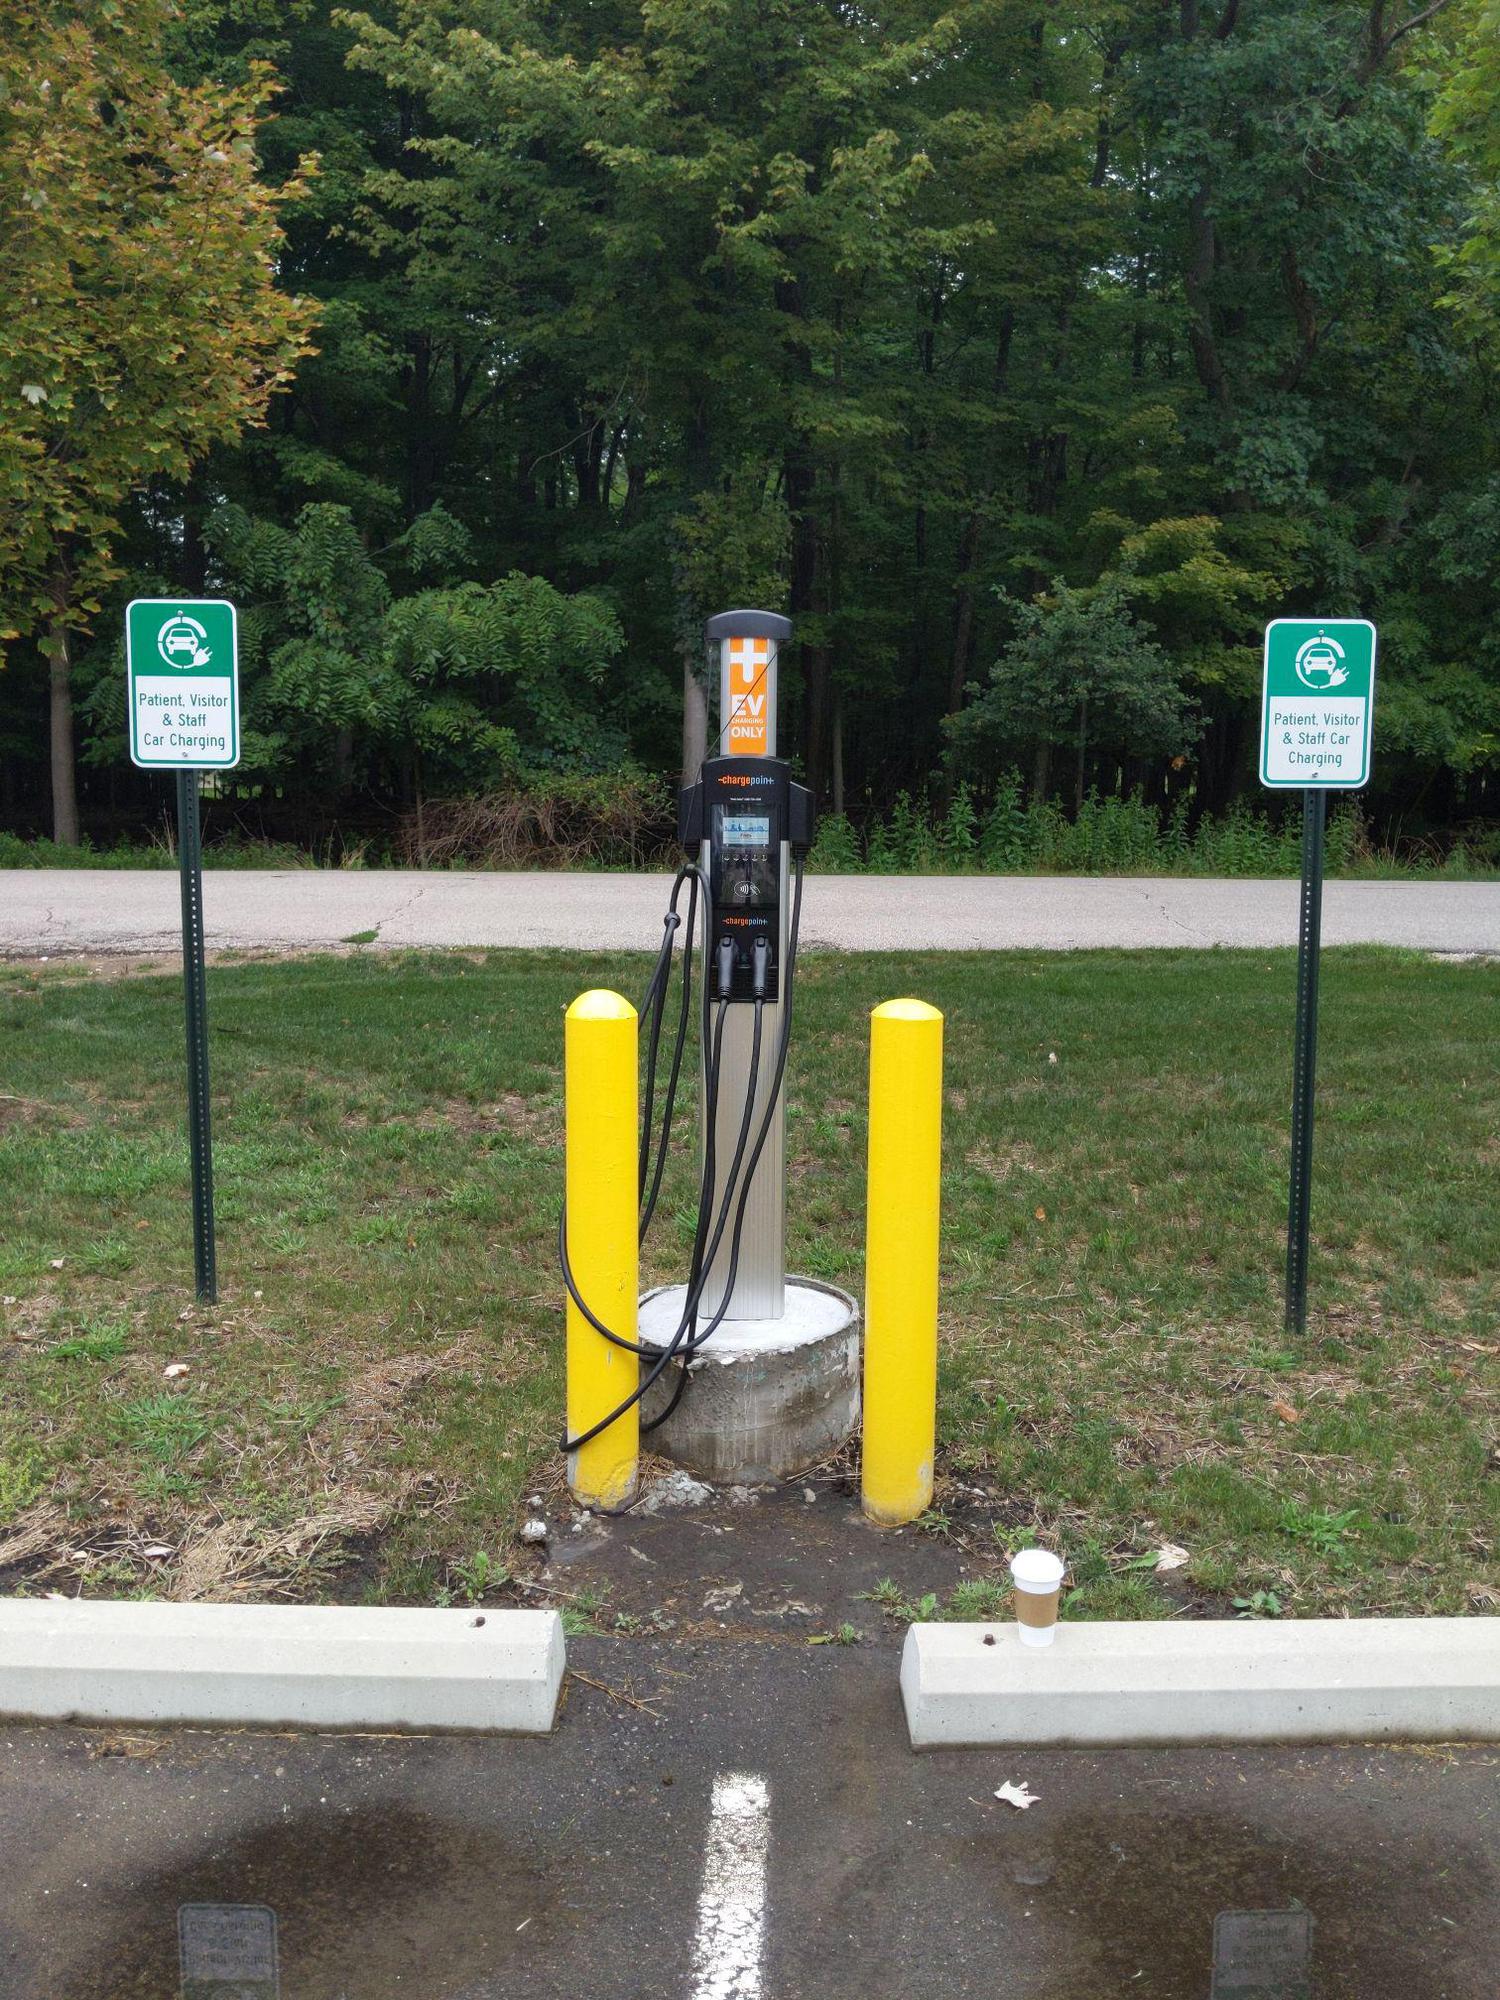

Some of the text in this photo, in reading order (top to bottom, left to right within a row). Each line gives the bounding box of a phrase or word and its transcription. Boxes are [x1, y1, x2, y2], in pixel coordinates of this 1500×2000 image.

[190, 693, 229, 707] Visitor
[731, 693, 765, 716] EV
[162, 713, 207, 727] & Staff
[1323, 712, 1361, 726] Visitor
[731, 726, 765, 738] ONLY
[1282, 731, 1350, 745] & Staff Car
[144, 733, 226, 751] Car Charging
[1288, 751, 1342, 768] Charging
